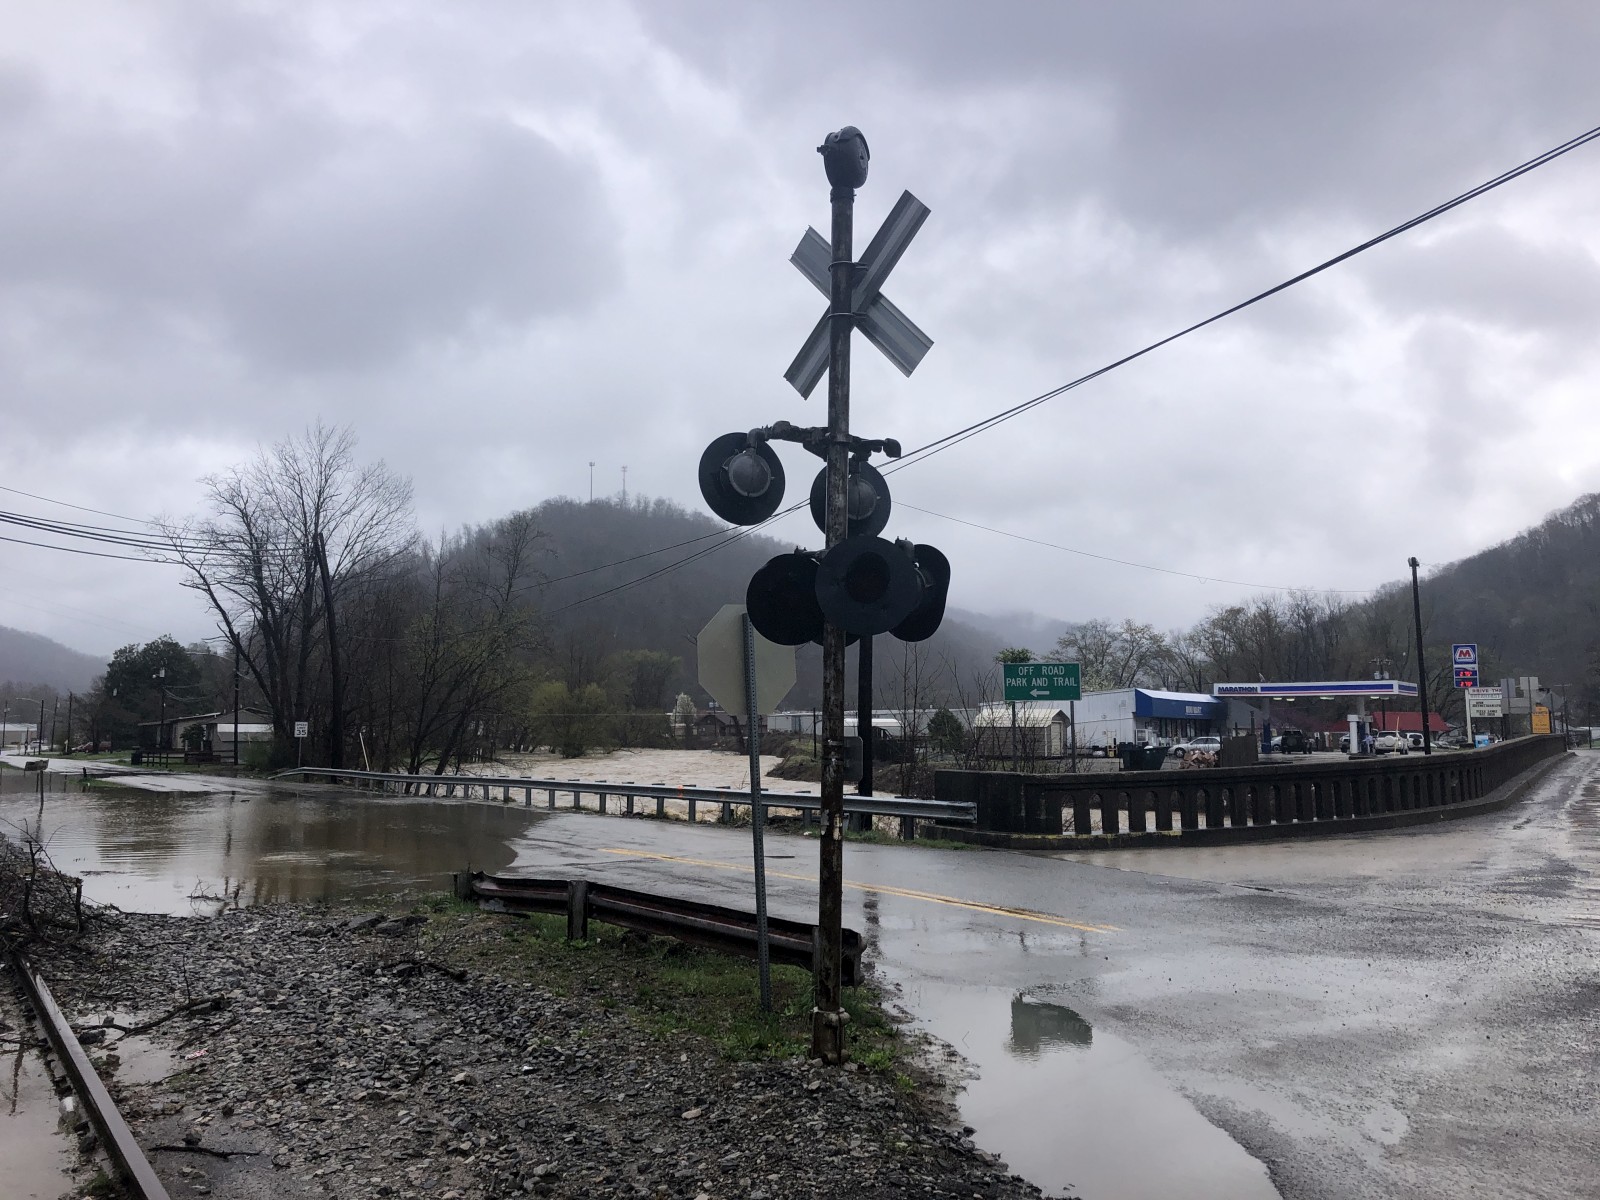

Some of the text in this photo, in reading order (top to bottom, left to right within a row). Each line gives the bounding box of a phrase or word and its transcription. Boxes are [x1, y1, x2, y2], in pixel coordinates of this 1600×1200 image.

[1018, 665, 1065, 676] OFF ROAD
[1006, 677, 1078, 687] PARK AND TRAIL
